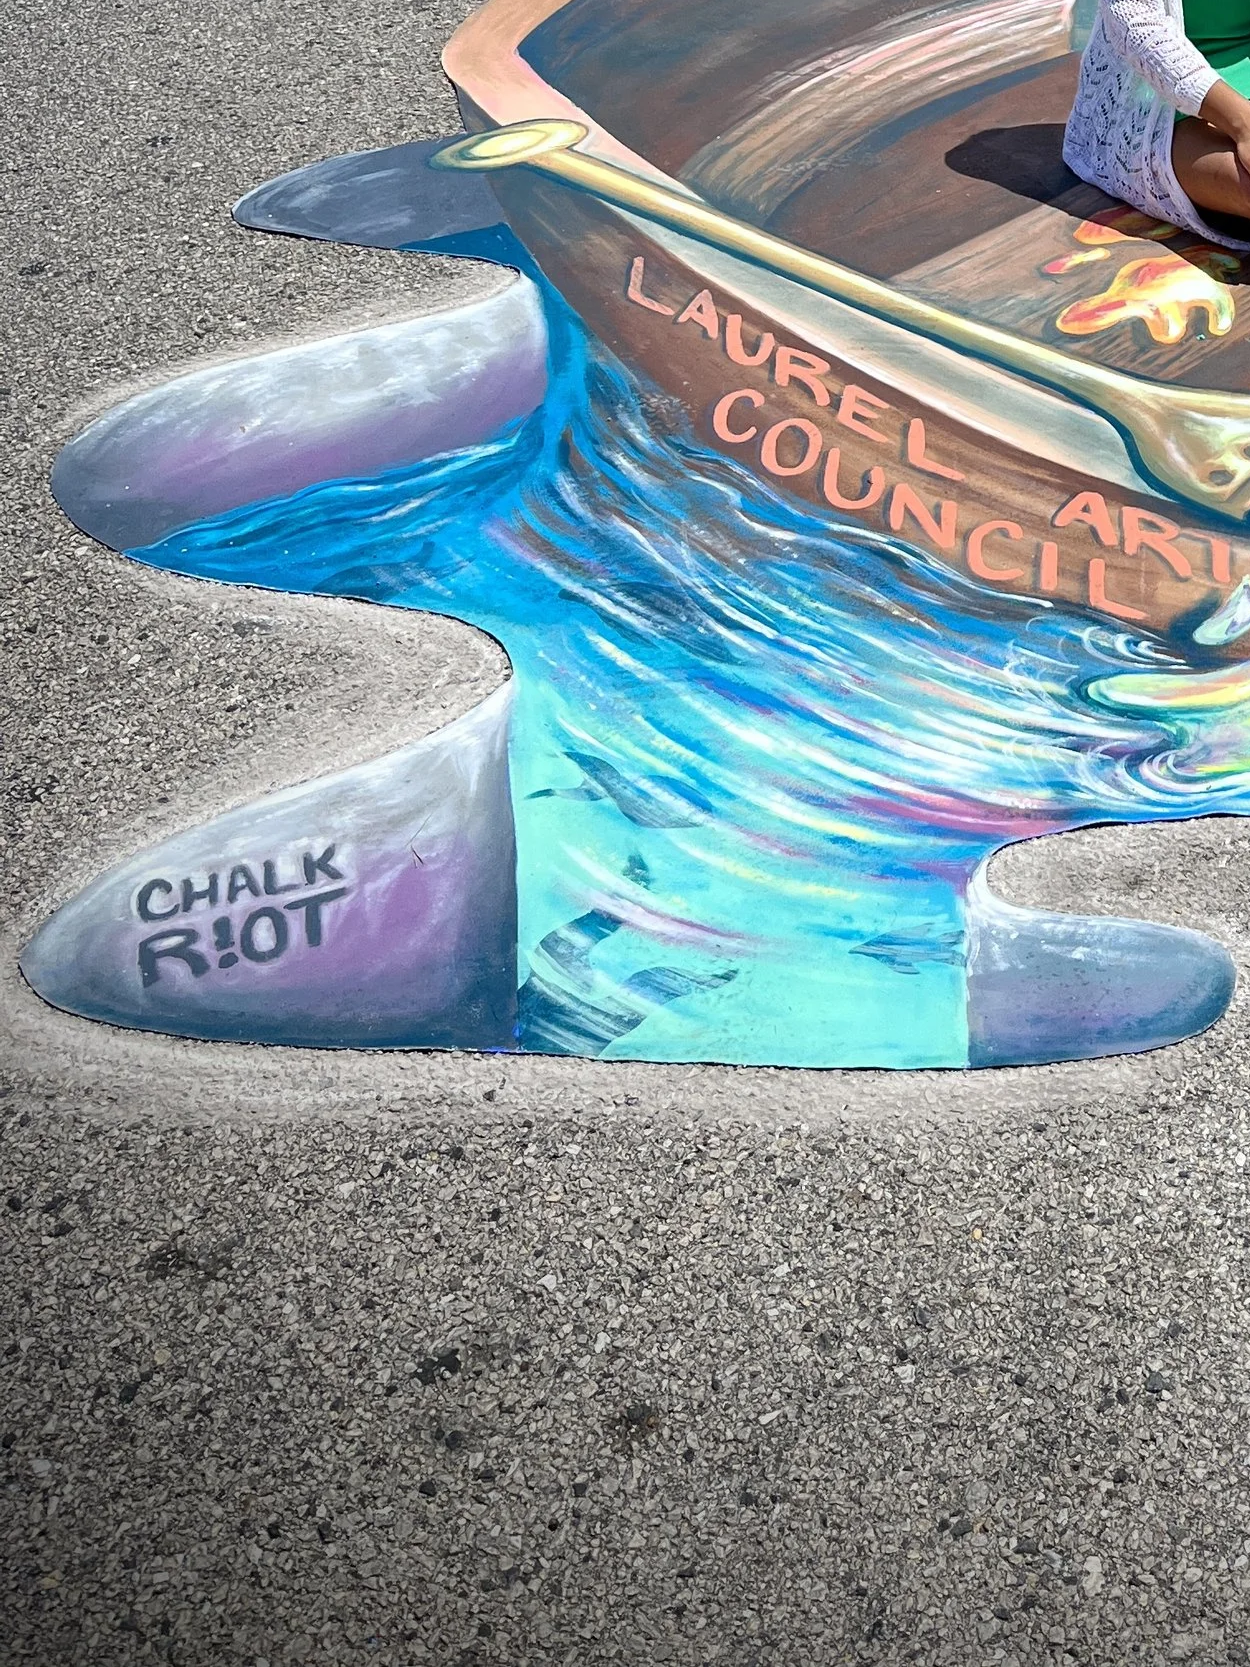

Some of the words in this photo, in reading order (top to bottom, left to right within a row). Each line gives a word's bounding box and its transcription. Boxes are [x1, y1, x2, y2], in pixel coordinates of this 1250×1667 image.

[625, 256, 966, 481] LAUREL
[712, 389, 1149, 621] COUNCIL
[136, 844, 344, 923] CHALK
[138, 887, 349, 989] R!OT
